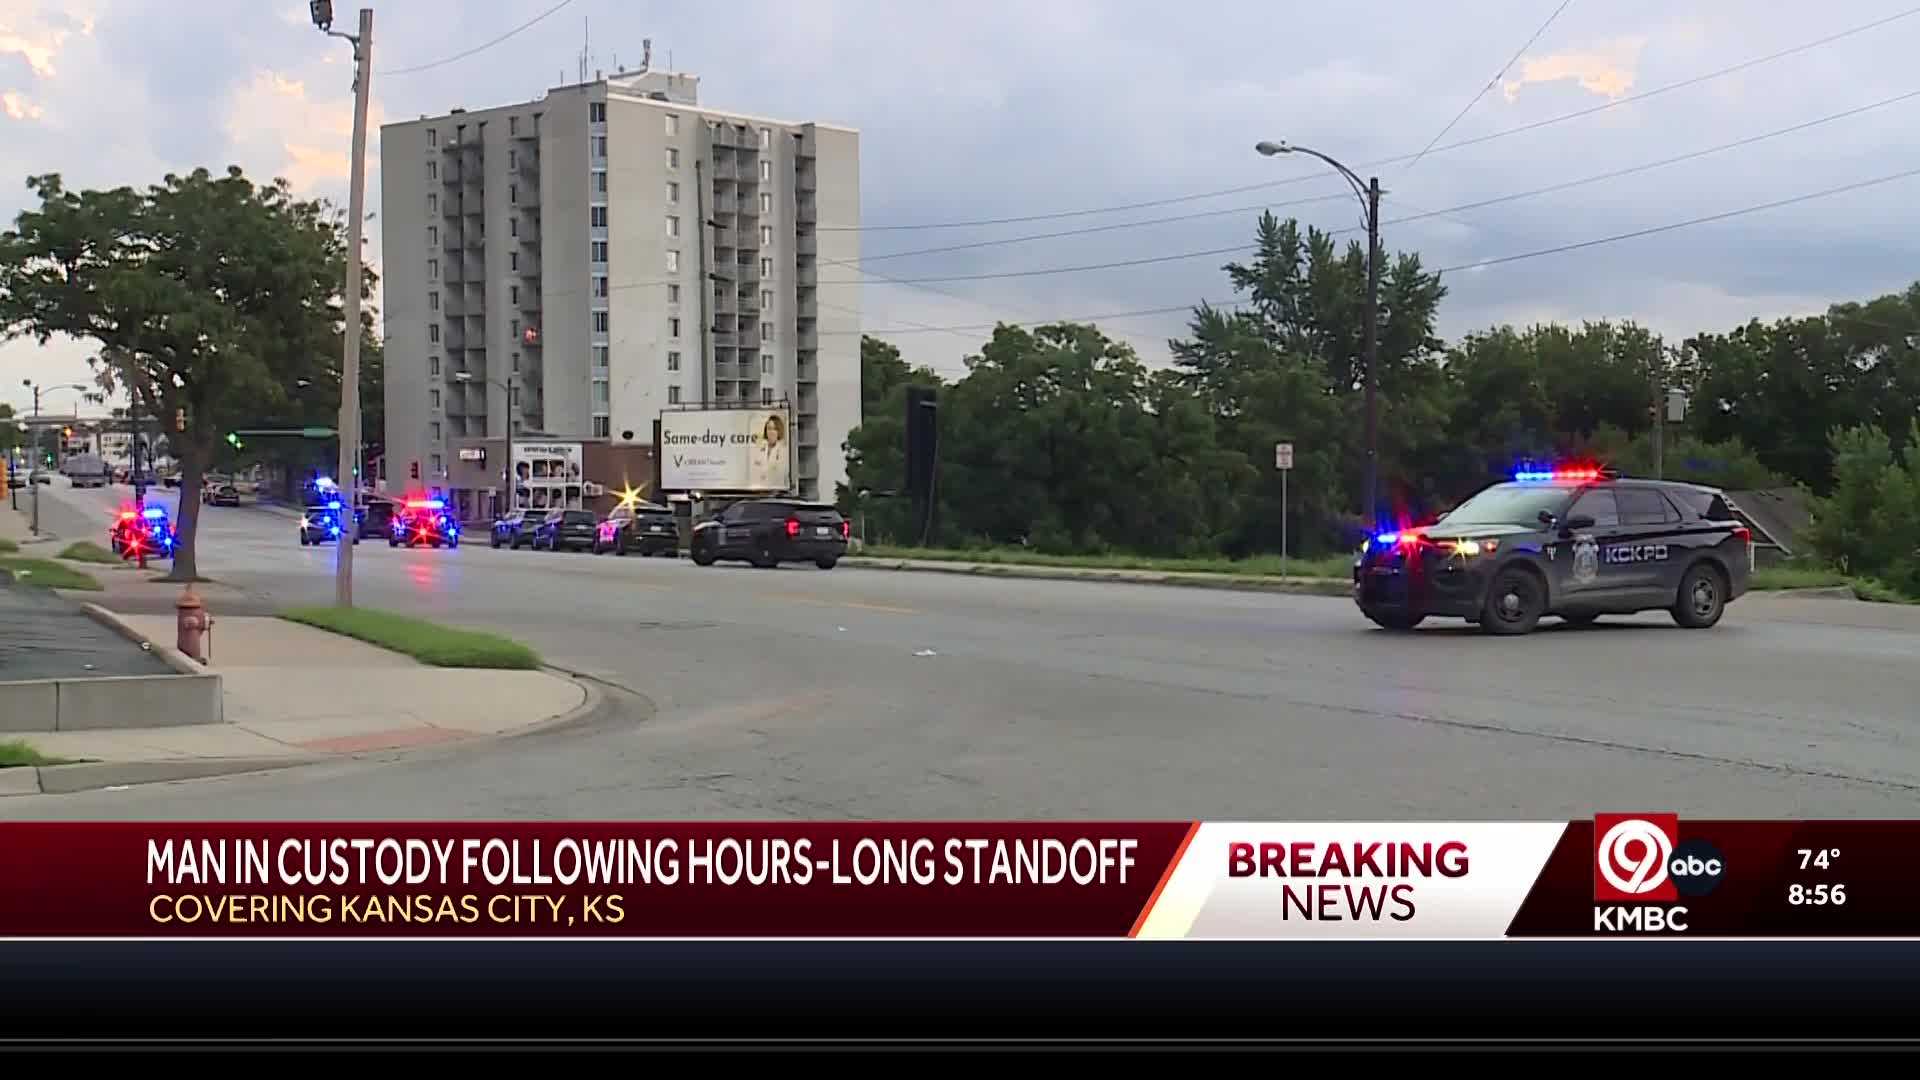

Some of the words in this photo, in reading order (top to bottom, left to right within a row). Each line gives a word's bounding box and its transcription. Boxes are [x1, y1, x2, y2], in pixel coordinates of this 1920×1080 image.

[663, 428, 726, 449] Same-day
[730, 433, 759, 445] care
[1605, 544, 1669, 563] KCKPD
